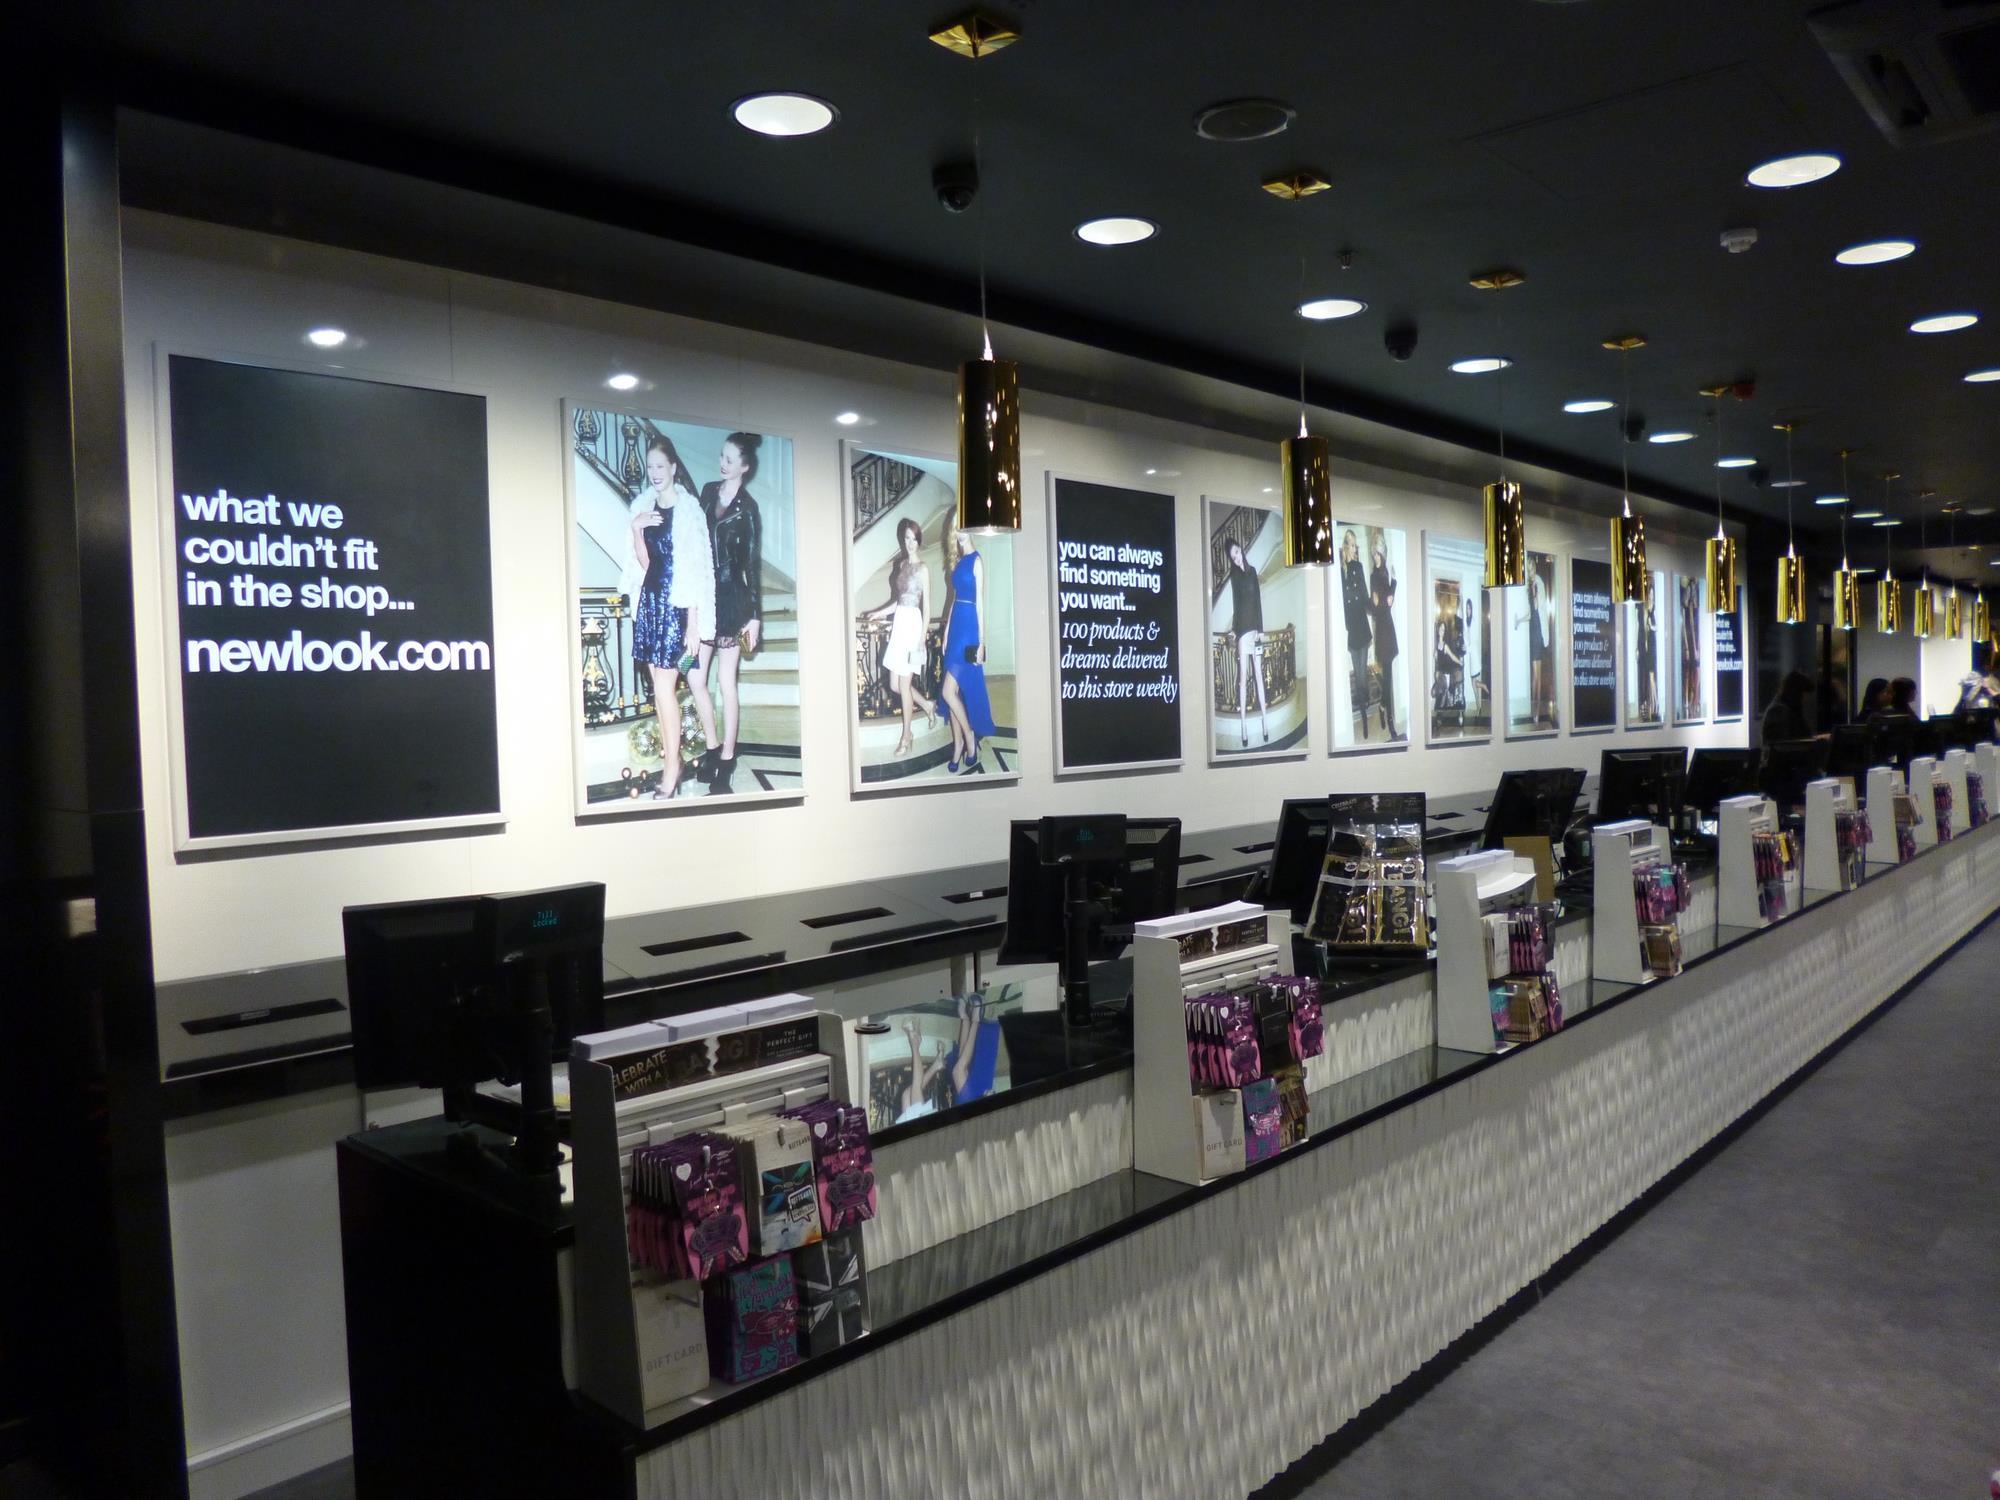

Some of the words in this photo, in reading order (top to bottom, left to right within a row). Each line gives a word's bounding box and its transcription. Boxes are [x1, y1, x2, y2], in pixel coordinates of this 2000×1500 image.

[182, 489, 280, 527] what
[288, 499, 344, 530] we
[184, 534, 338, 568] couldn't
[343, 538, 379, 571] fit
[1059, 541, 1086, 561] you
[1089, 545, 1115, 562] can
[1118, 544, 1163, 569] always
[1059, 562, 1087, 584] find
[1090, 568, 1161, 593] something
[186, 572, 221, 607] in
[229, 574, 292, 609] the
[301, 577, 415, 616] shop...
[1060, 592, 1087, 612] you
[1090, 593, 1136, 612] want...
[1062, 622, 1087, 639] 100
[1088, 617, 1144, 647] products
[1146, 621, 1160, 641] &
[186, 630, 490, 673] newlook.com
[1061, 645, 1111, 669] dreams
[1112, 646, 1169, 669] delivered
[1062, 681, 1077, 699] to
[1078, 675, 1103, 699] this
[1104, 681, 1133, 698] store
[1136, 675, 1178, 703] weekly
[614, 1049, 668, 1088] ELEBRATE
[625, 1075, 652, 1094] WITH
[1206, 1143, 1222, 1152] GIFT
[646, 1352, 673, 1372] GIFT
[674, 1343, 702, 1361] CARD
